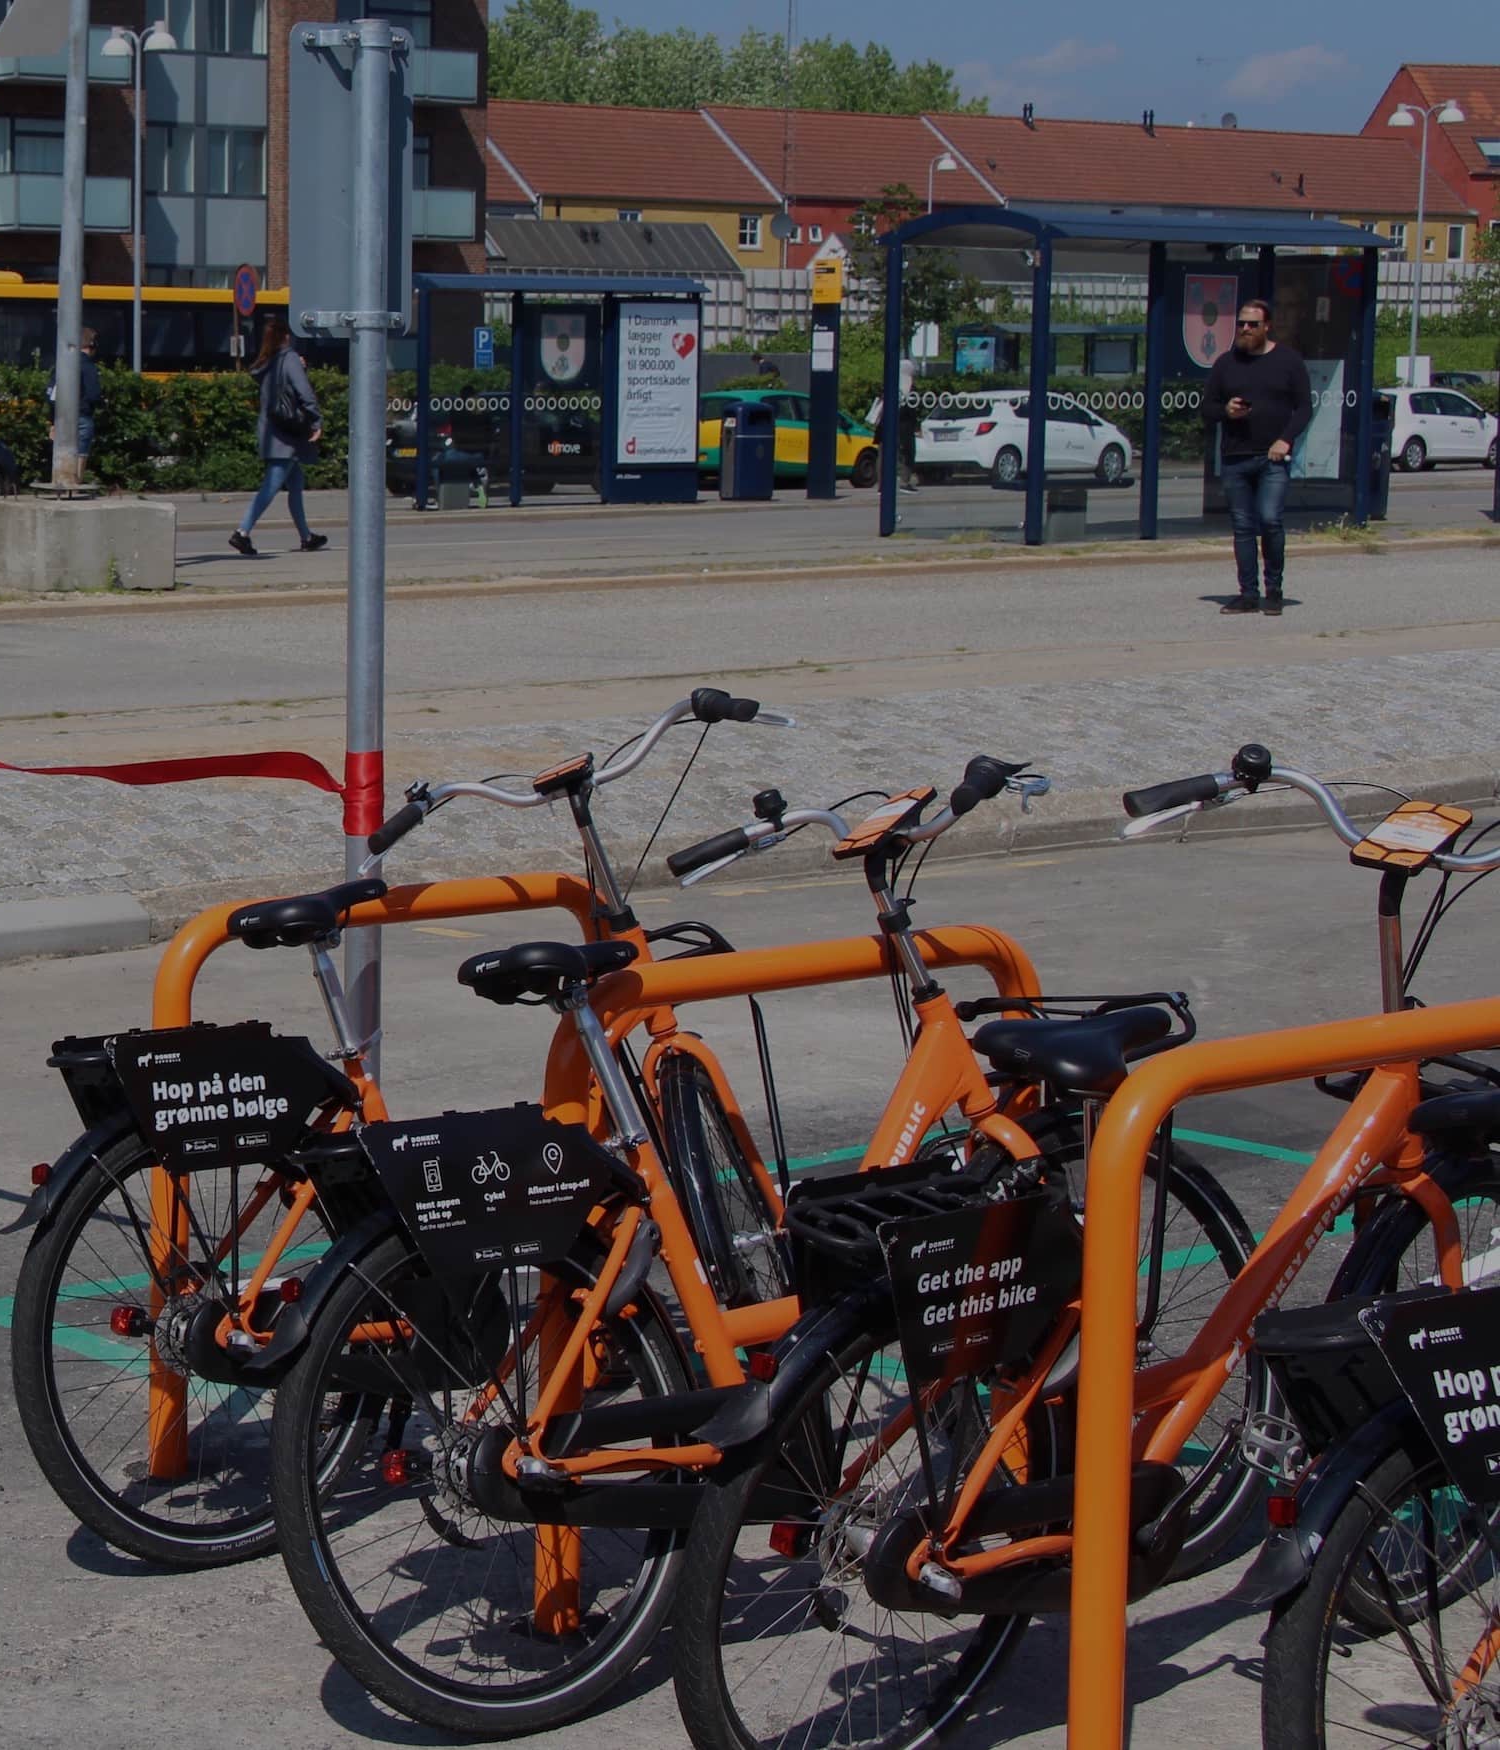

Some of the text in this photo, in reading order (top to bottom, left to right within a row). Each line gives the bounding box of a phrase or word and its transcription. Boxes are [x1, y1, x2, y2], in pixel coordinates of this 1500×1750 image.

[635, 315, 677, 326] Danmark
[479, 331, 489, 349] P
[628, 330, 662, 343] lægger
[628, 346, 660, 357] vi krop
[628, 360, 675, 370] til 900.000
[627, 375, 690, 386] sportsskader
[627, 389, 652, 403] årligt
[152, 1072, 266, 1104] Hop på den
[154, 1095, 288, 1132] grønne bølge
[411, 1134, 439, 1143] DONKEY
[889, 1101, 926, 1167] PUBLIC
[528, 1184, 555, 1196] Aflever
[560, 1178, 590, 1191] drop-off
[484, 1190, 506, 1203] Cykel
[1304, 1151, 1372, 1250] REPUBLIC
[415, 1198, 460, 1211] Hent appen
[418, 1210, 452, 1223] og lås op
[928, 1238, 955, 1249] DONKEY
[917, 1257, 1023, 1293] Get the app
[923, 1284, 1037, 1326] Get this bike
[1429, 1327, 1460, 1338] DONKEY
[1433, 1368, 1487, 1401] Hop
[1443, 1403, 1500, 1444] grøn
